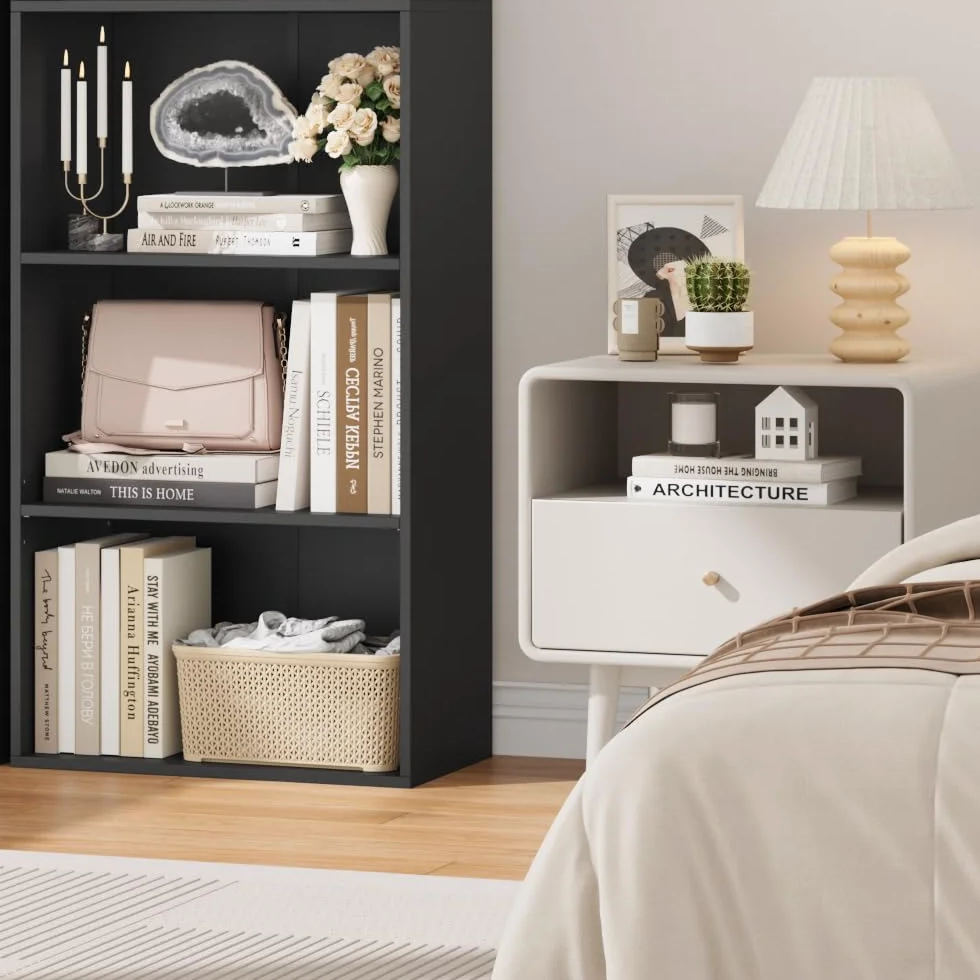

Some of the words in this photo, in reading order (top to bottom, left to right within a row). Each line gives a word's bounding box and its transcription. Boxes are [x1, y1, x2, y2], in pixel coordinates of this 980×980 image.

[141, 232, 157, 247] AIR
[158, 233, 177, 247] AND
[179, 232, 197, 247] FIRE
[373, 347, 384, 397] MARINO
[288, 370, 303, 404] Isamu
[284, 407, 300, 458] Noguchi
[316, 390, 331, 456] SCHIELE
[373, 401, 384, 459] STEPHEN
[86, 460, 138, 473] AVEDON
[142, 462, 204, 479] advertising
[674, 464, 695, 474] HOME
[697, 465, 721, 475] HOUSE
[725, 466, 739, 475] THE
[741, 467, 778, 477] BRINGING
[79, 488, 102, 496] WALTON
[110, 485, 138, 499] THIS
[142, 487, 153, 500] IS
[156, 488, 195, 501] HOME
[652, 483, 809, 501] ARCHITECTURE
[147, 575, 159, 599] STAY
[81, 605, 95, 622] НЕ
[127, 585, 140, 639] Arianna
[147, 602, 159, 628] WITH
[81, 624, 95, 658] БЕРИ
[147, 631, 159, 646] ME
[123, 645, 140, 720] Huffington
[147, 653, 159, 697] AYOBAMI
[81, 673, 95, 726] ГОЛОВУ
[147, 700, 159, 745] ADEBAYO
